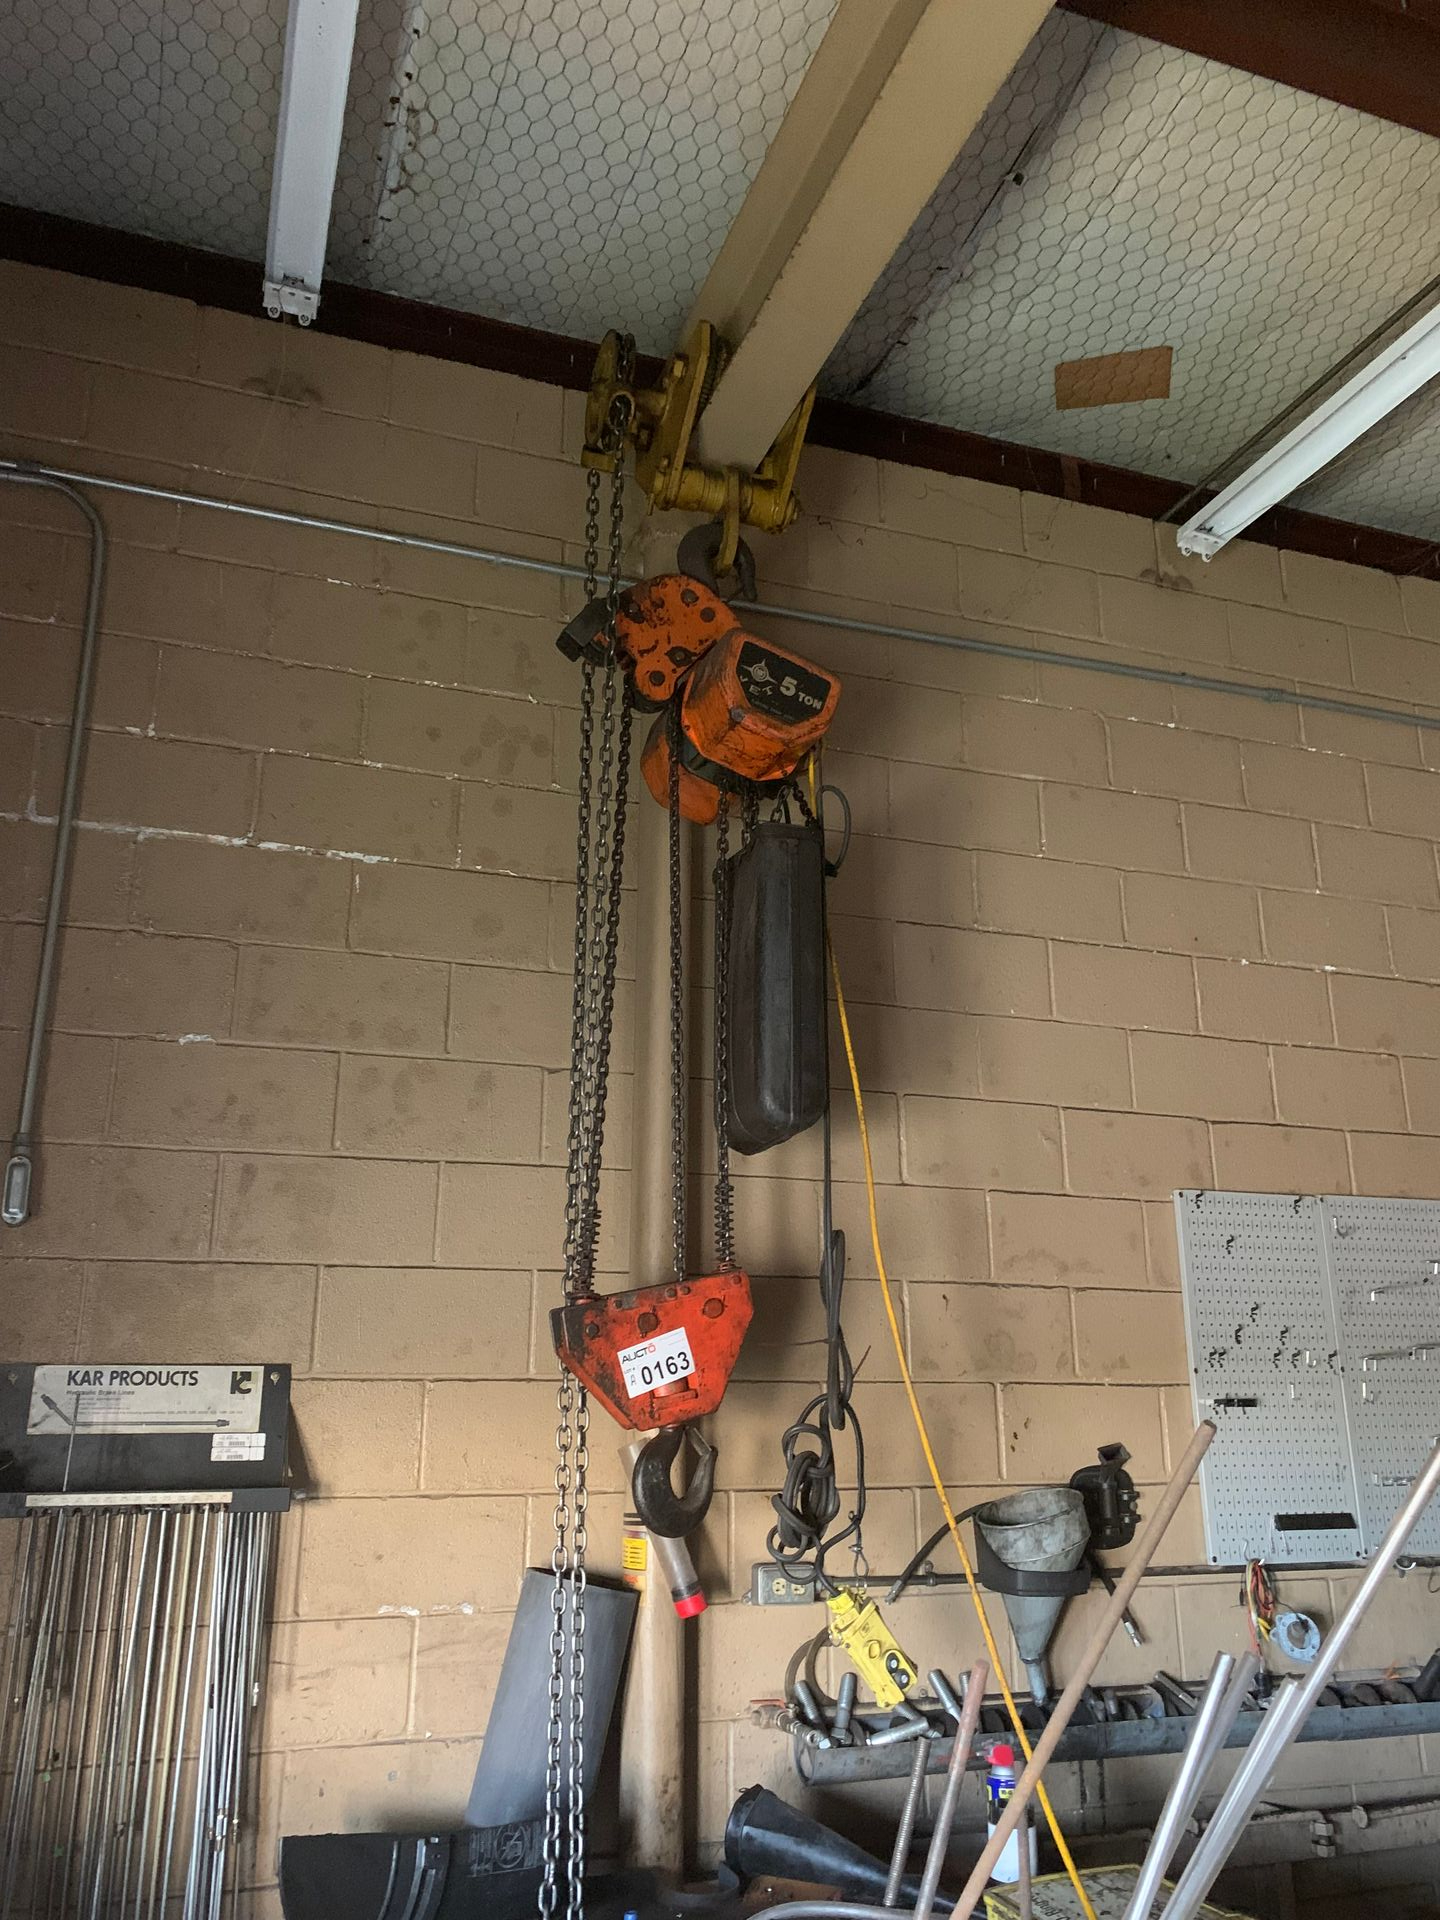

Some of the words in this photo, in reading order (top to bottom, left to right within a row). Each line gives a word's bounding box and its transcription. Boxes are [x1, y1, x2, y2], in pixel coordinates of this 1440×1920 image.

[780, 676, 798, 697] 5
[798, 691, 823, 710] TON
[67, 1370, 104, 1386] KAR
[109, 1370, 199, 1386] PRODUCTS
[641, 1352, 690, 1386] 0163
